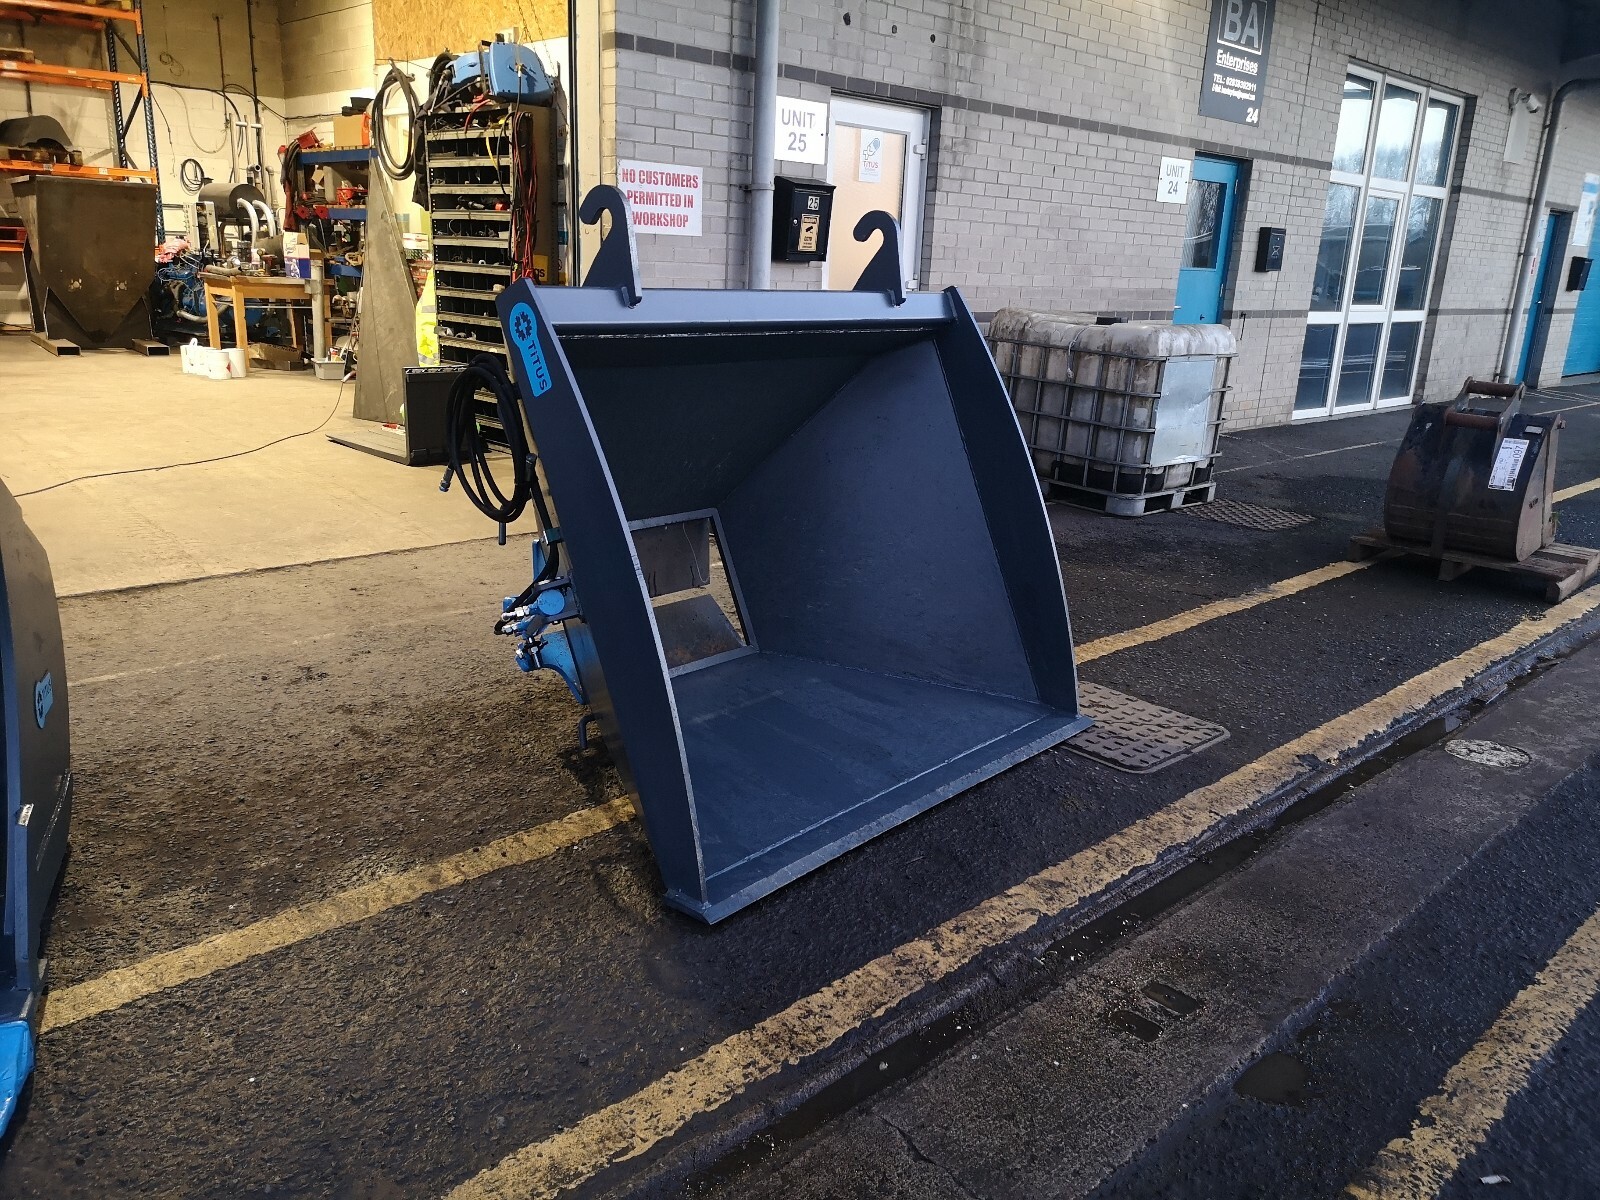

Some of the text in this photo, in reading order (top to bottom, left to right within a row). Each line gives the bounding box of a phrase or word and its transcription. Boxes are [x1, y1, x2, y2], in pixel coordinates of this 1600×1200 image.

[1223, 0, 1260, 49] BA
[1216, 49, 1259, 74] Enterprises
[1213, 73, 1226, 85] TEL:
[781, 108, 816, 129] UNIT
[1245, 107, 1259, 124] 24
[787, 131, 807, 153] 25
[621, 168, 699, 189] NO CUSTOMERS
[1166, 164, 1185, 178] UNIT
[1167, 180, 1179, 195] 24
[626, 189, 694, 209] PERMITTED IN
[808, 197, 819, 210] 25
[631, 210, 689, 228] WORKSHOP
